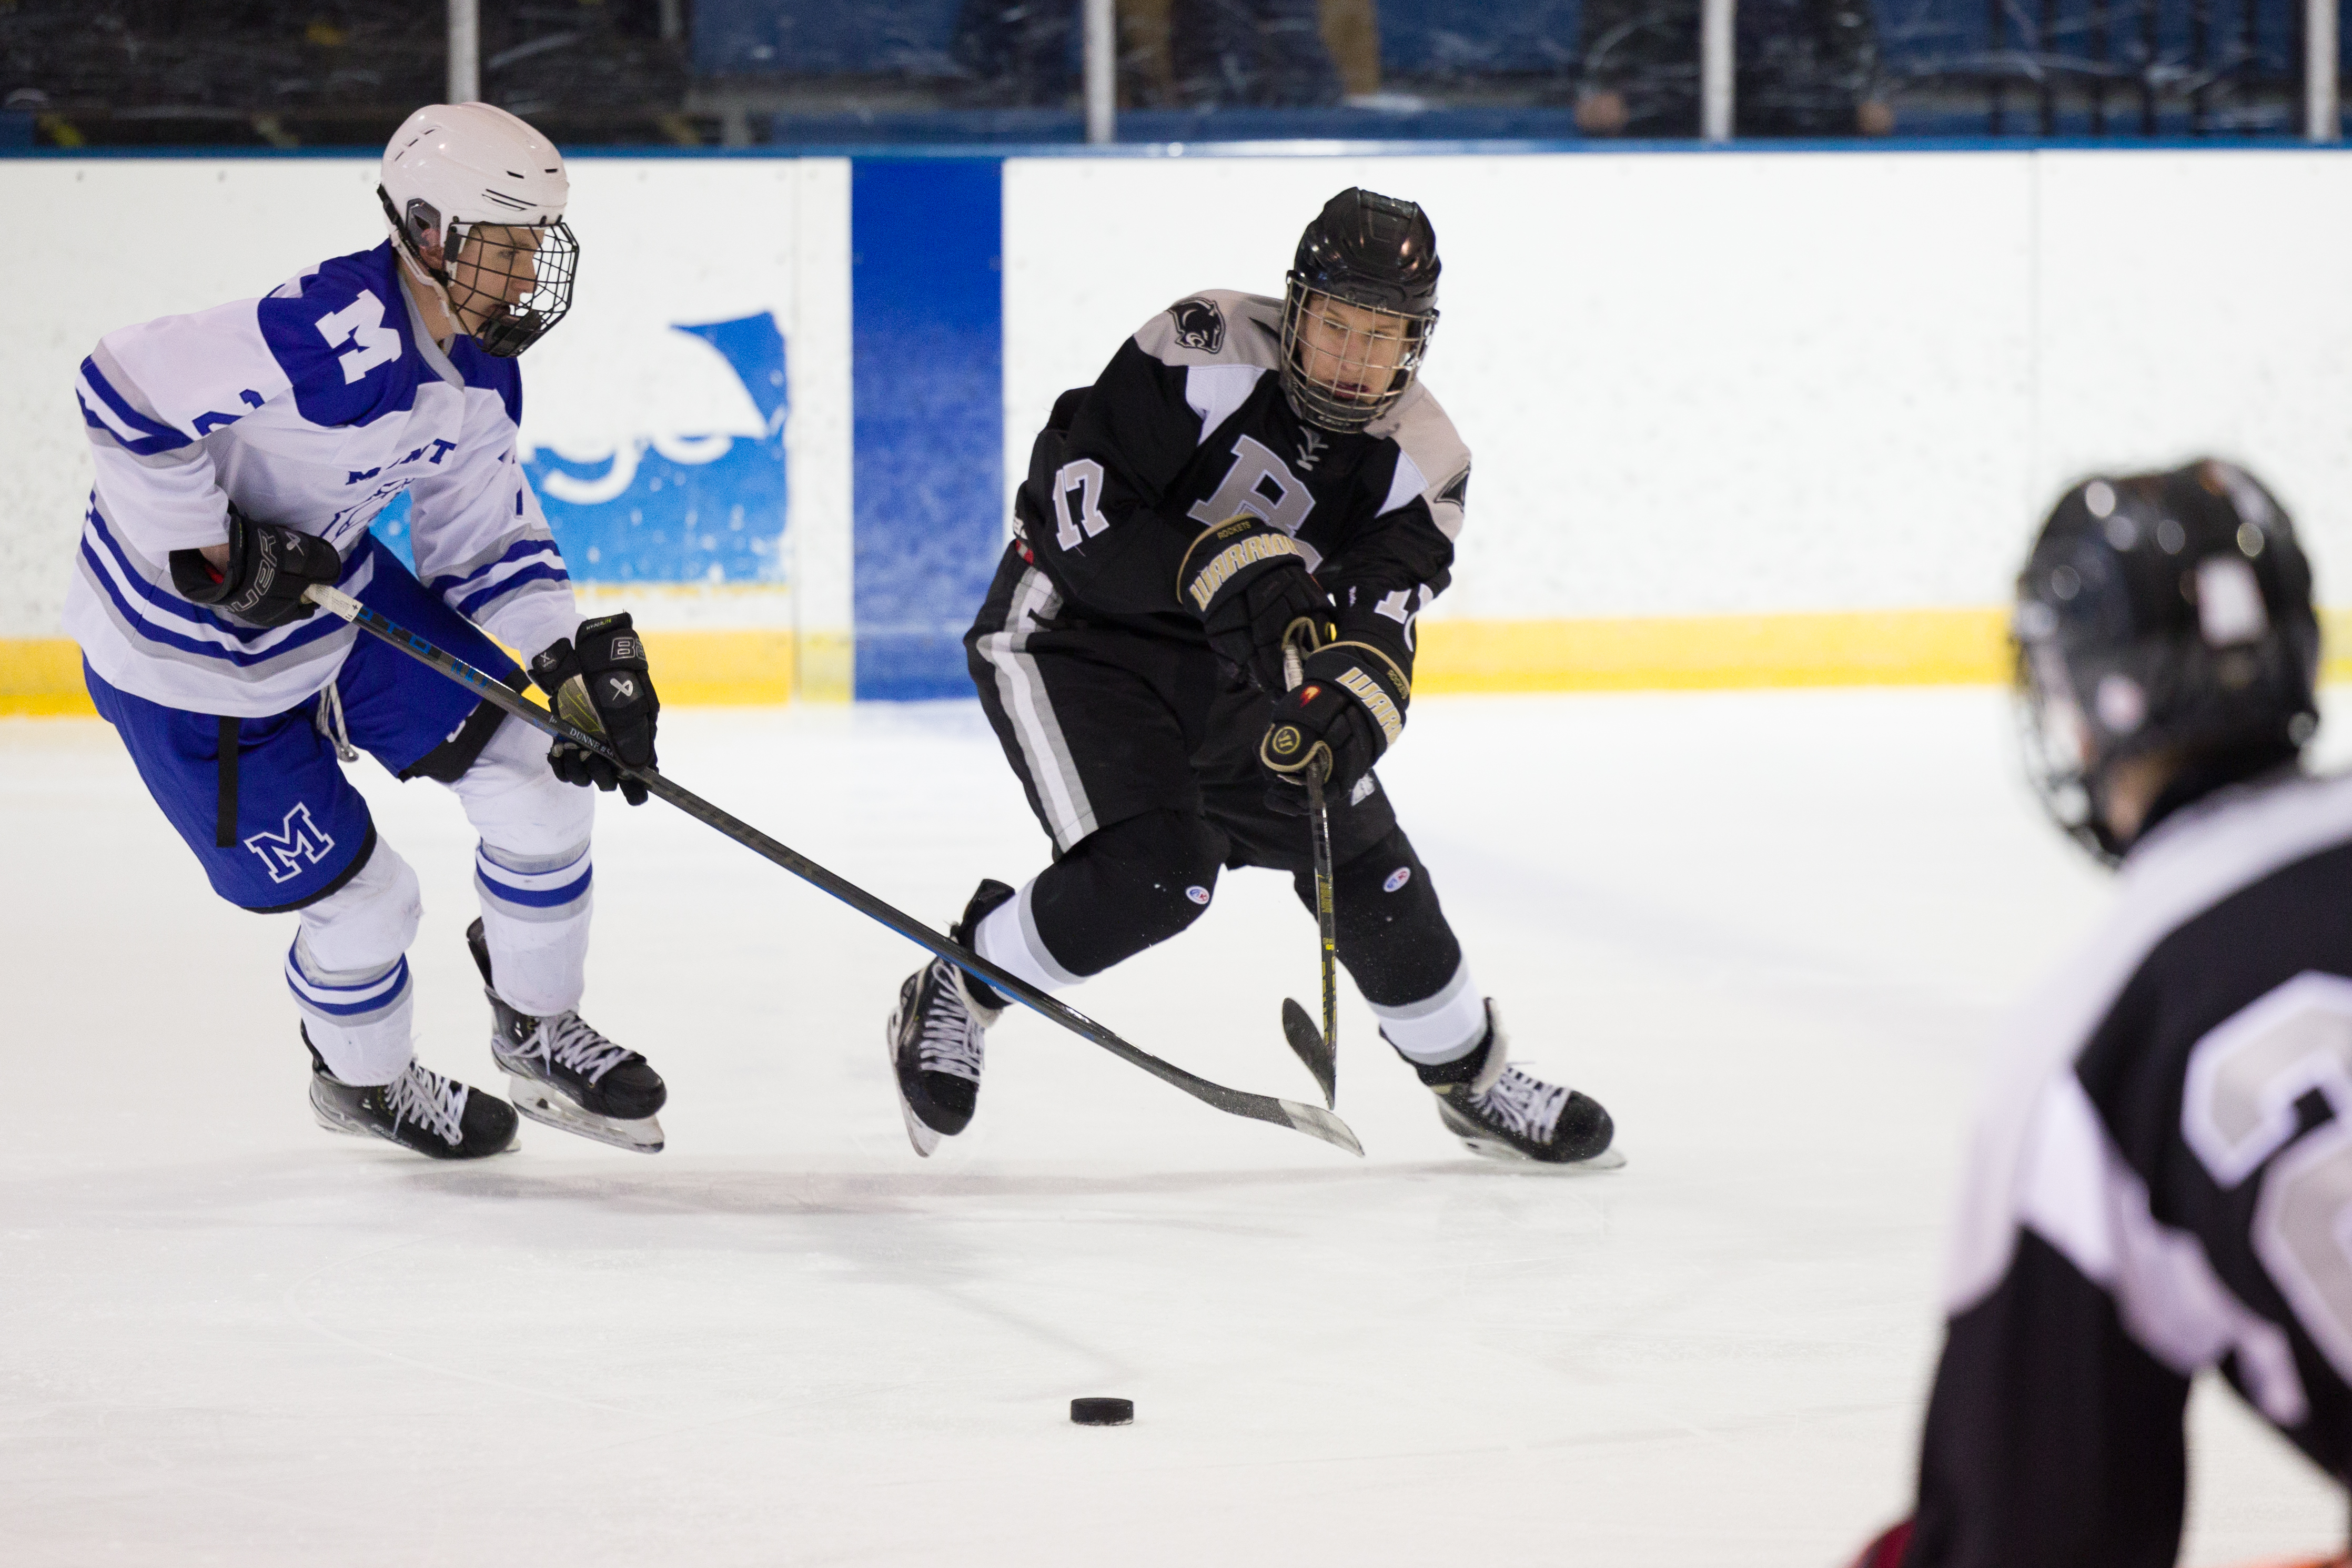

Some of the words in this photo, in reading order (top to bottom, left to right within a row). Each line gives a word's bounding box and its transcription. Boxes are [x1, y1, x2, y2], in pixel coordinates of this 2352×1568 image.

[315, 289, 402, 386] M
[1053, 458, 1110, 552] 17
[1216, 520, 1251, 541] ROCKETS
[1189, 533, 1300, 613] WARRIO
[569, 727, 600, 750] DUNNE
[243, 801, 336, 884] M
